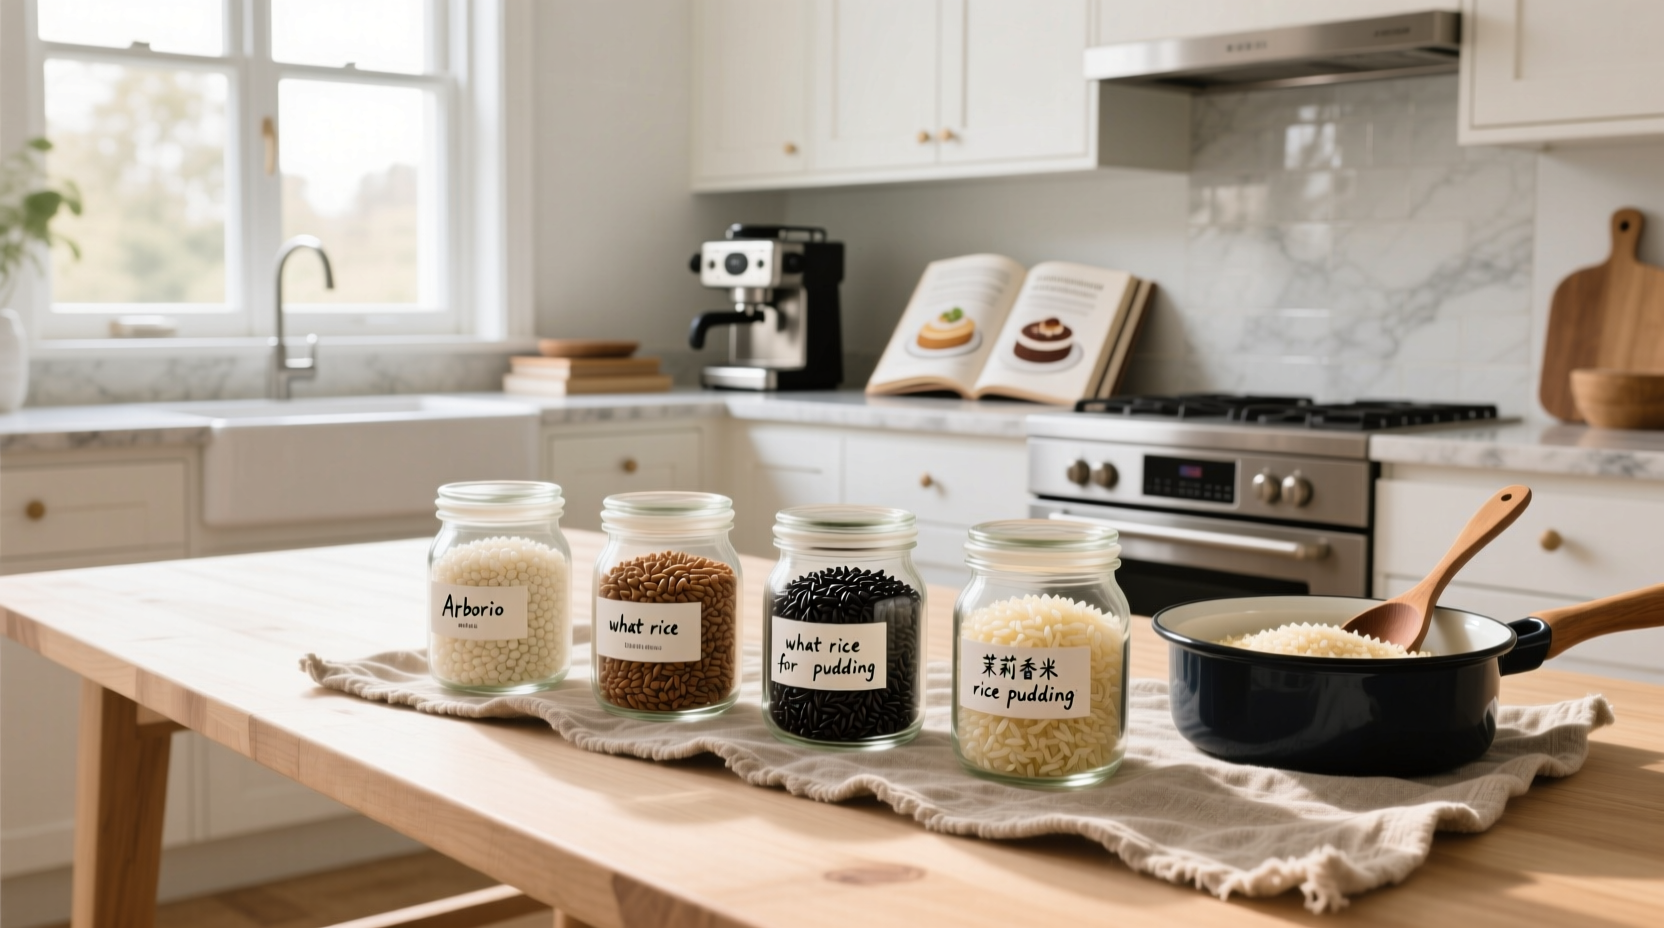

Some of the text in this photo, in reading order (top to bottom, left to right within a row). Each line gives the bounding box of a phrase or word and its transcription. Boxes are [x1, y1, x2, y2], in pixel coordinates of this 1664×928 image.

[442, 593, 504, 618] Arborio
[609, 613, 679, 635] what rice
[785, 633, 861, 653] what rice
[777, 652, 876, 682] for pudding
[981, 653, 1059, 681] 茉莉香米
[973, 681, 1075, 711] rice pudding
